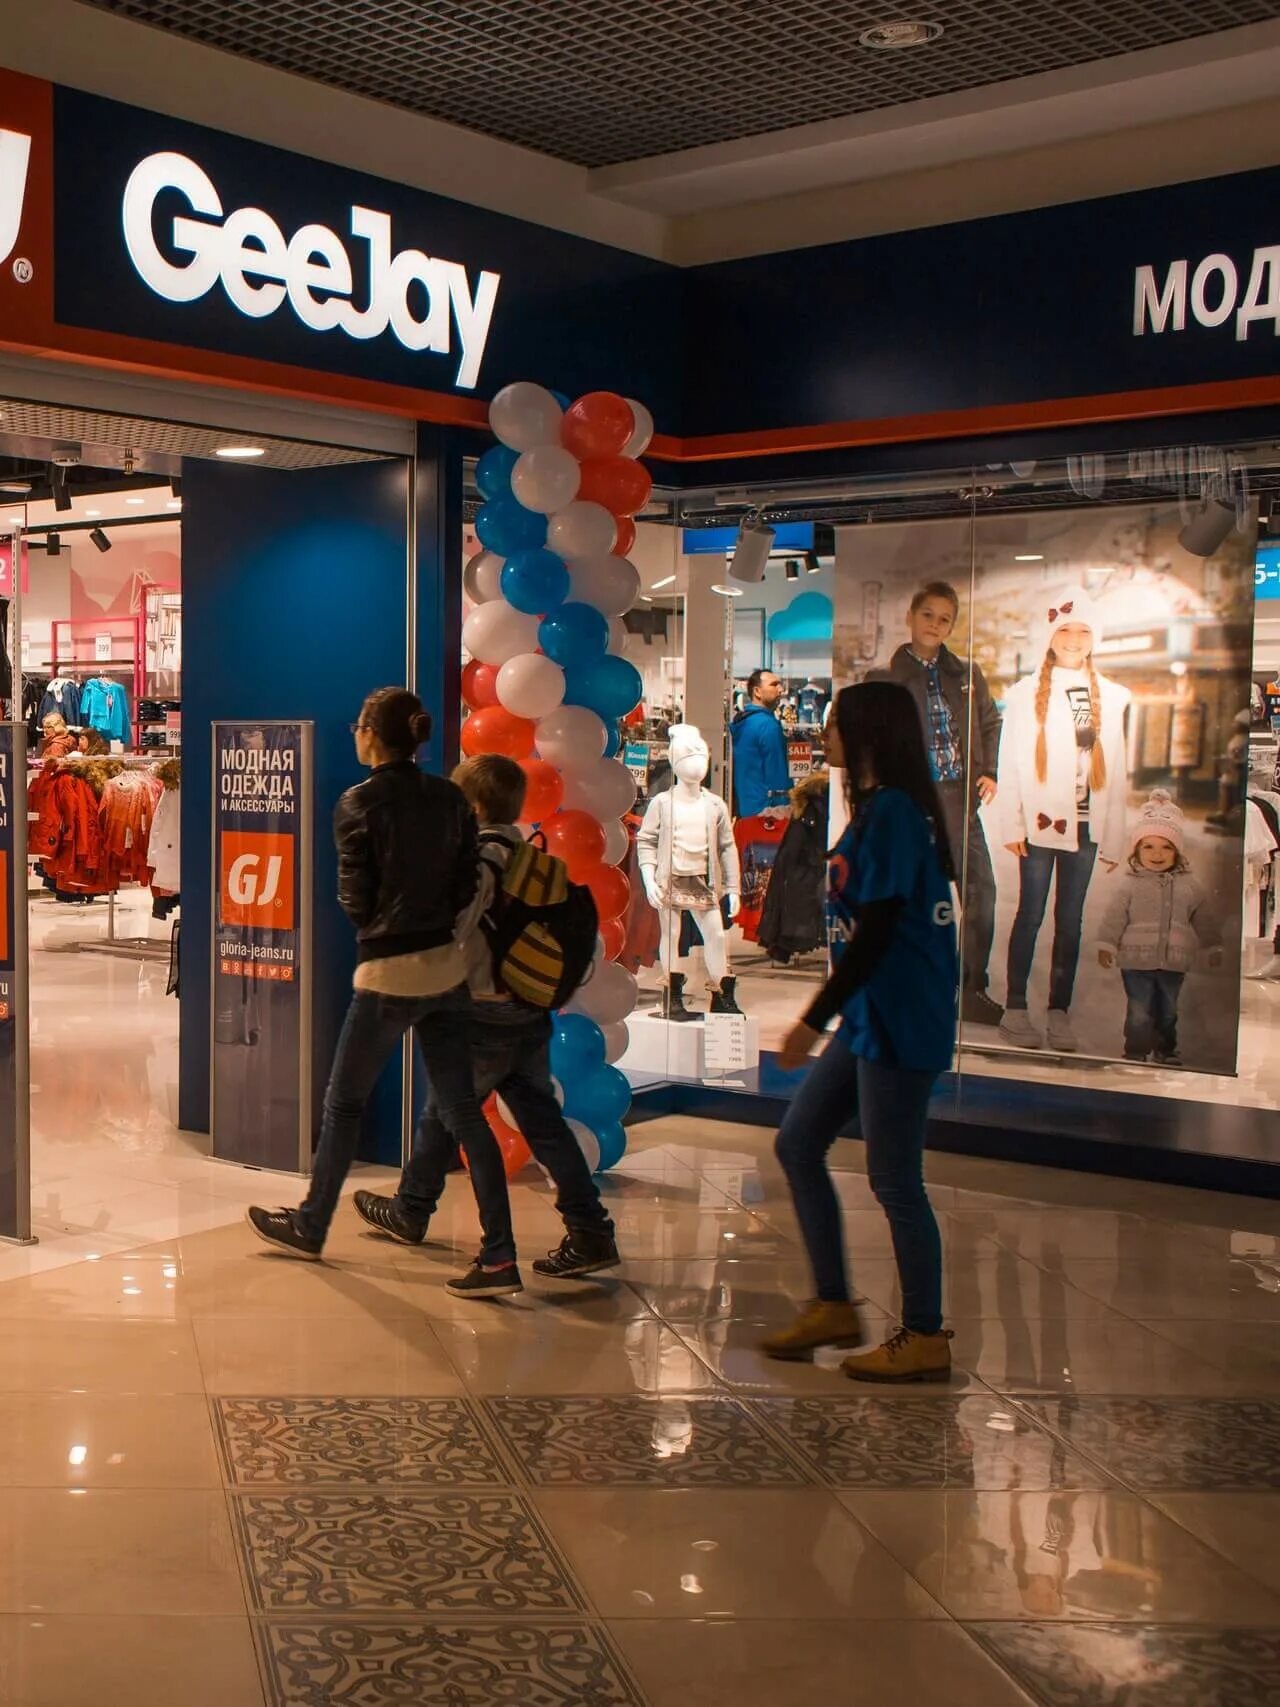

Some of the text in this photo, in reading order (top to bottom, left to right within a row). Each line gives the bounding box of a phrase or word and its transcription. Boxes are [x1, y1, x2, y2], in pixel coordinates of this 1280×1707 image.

[122, 151, 501, 390] GeeJay
[1133, 244, 1280, 341] МОД
[221, 749, 294, 774] МОДНАЯ
[793, 763, 809, 772] 299
[221, 774, 294, 798] ОДЕЖДА
[221, 799, 294, 813] И АКСЕССУАРЫ
[220, 942, 293, 961] gloria-jeans.ru
